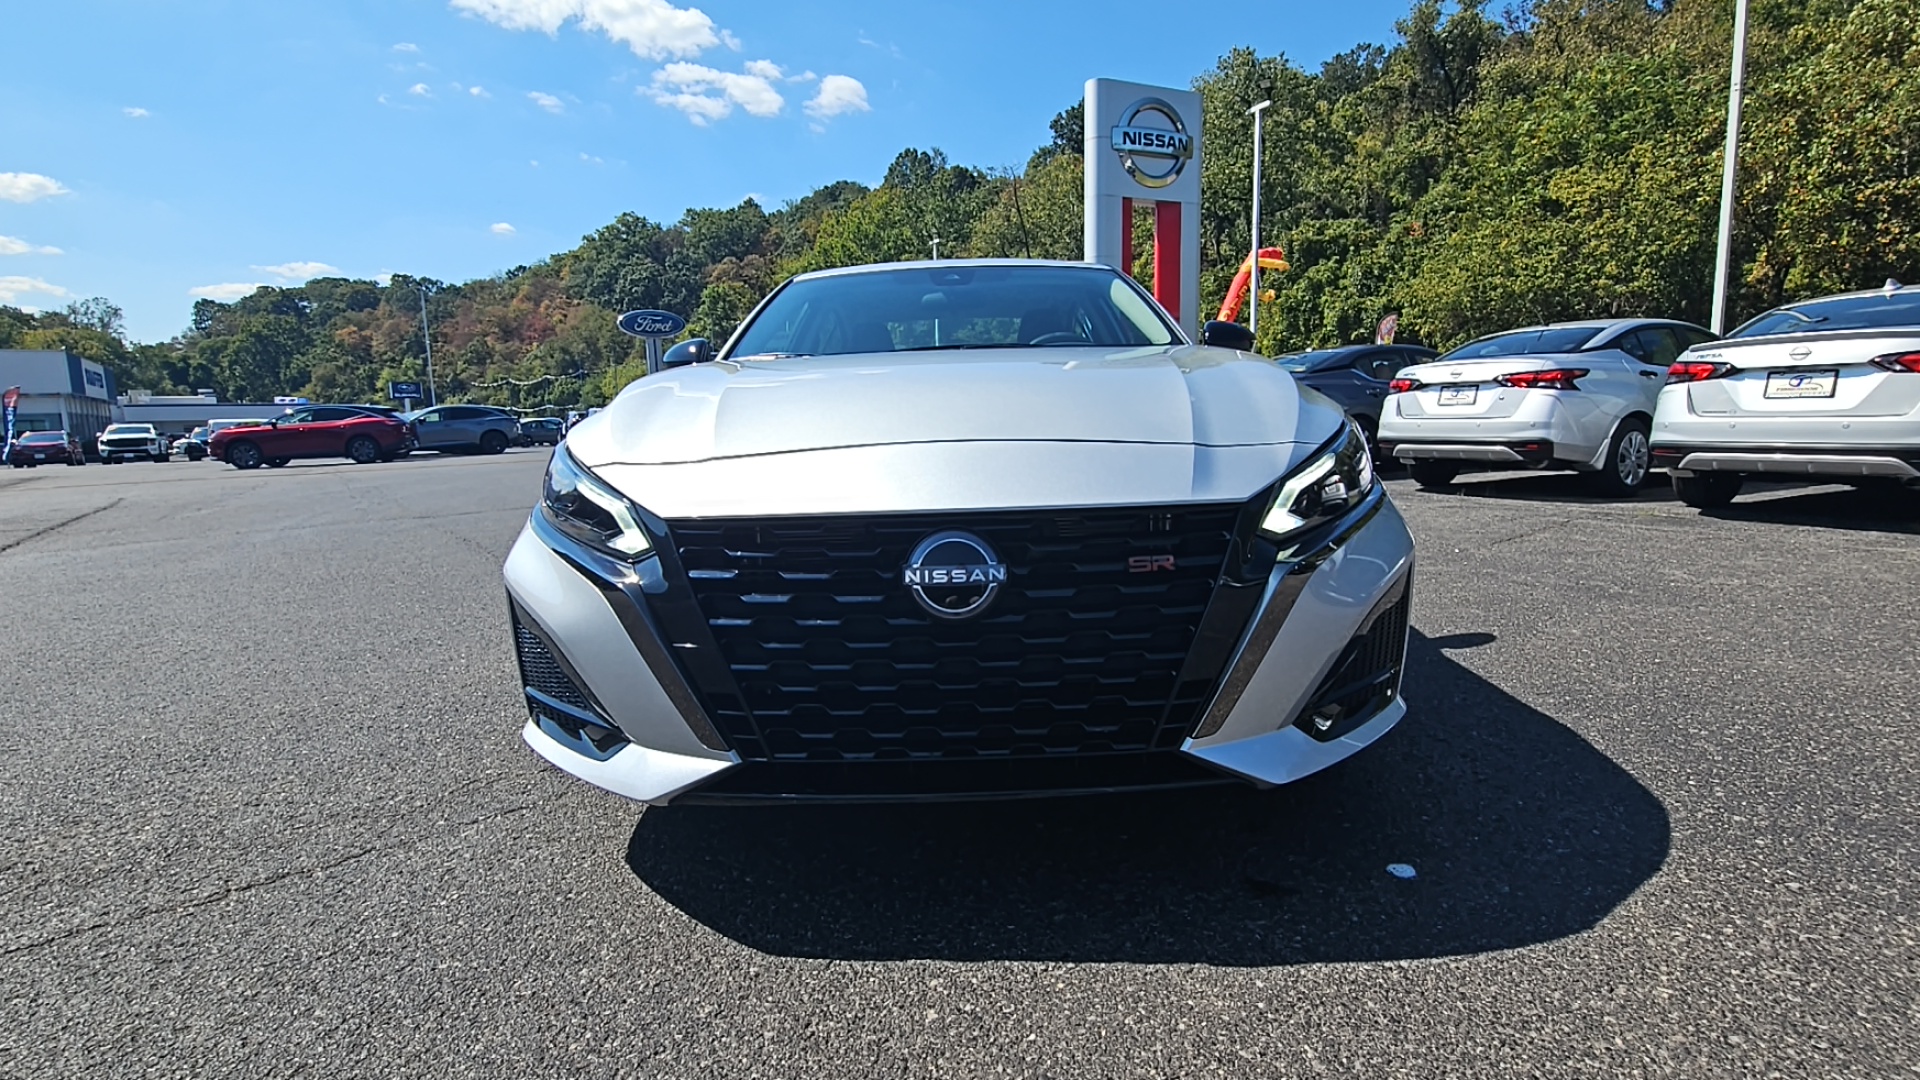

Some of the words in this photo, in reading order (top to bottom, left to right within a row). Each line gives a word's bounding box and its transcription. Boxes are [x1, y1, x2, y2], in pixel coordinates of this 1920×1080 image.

[1122, 131, 1188, 152] NISSAN
[634, 315, 672, 332] Ford
[1128, 555, 1176, 573] SR
[904, 567, 1004, 584] NISSAN
